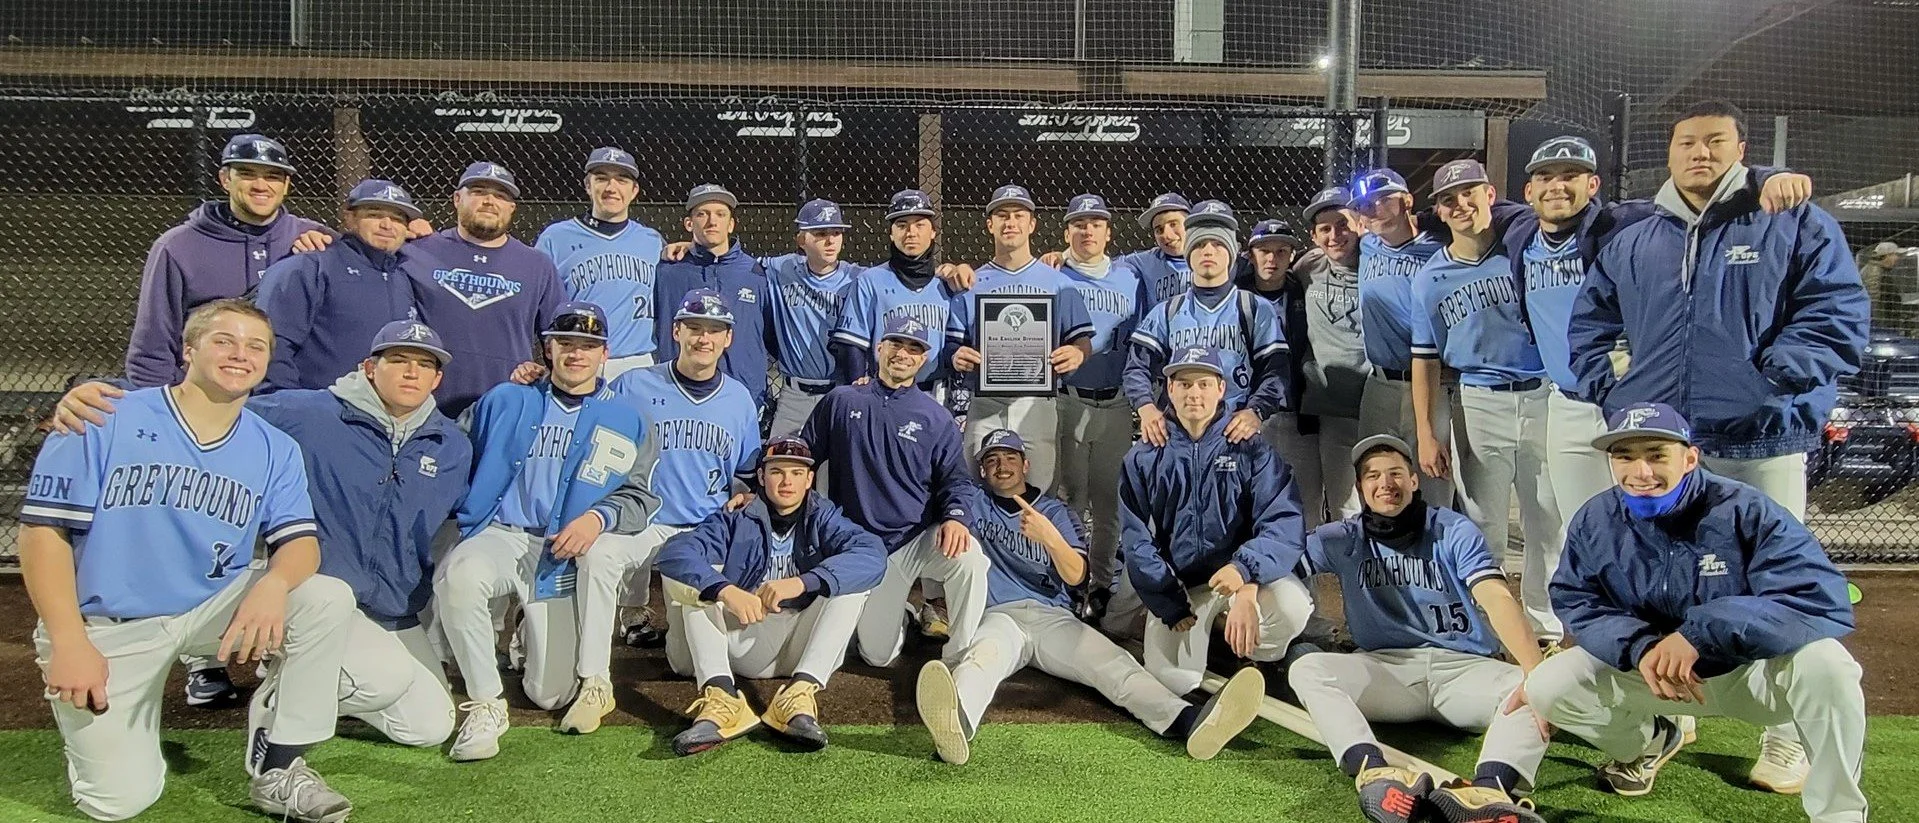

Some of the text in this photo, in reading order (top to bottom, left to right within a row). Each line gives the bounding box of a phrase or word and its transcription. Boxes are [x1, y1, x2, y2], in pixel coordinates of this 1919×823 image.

[433, 269, 521, 293] GREYHOUNDS
[1232, 364, 1249, 389] 6
[577, 424, 639, 488] P
[655, 419, 735, 461] EYHOUNDS
[1429, 602, 1469, 634] 15
